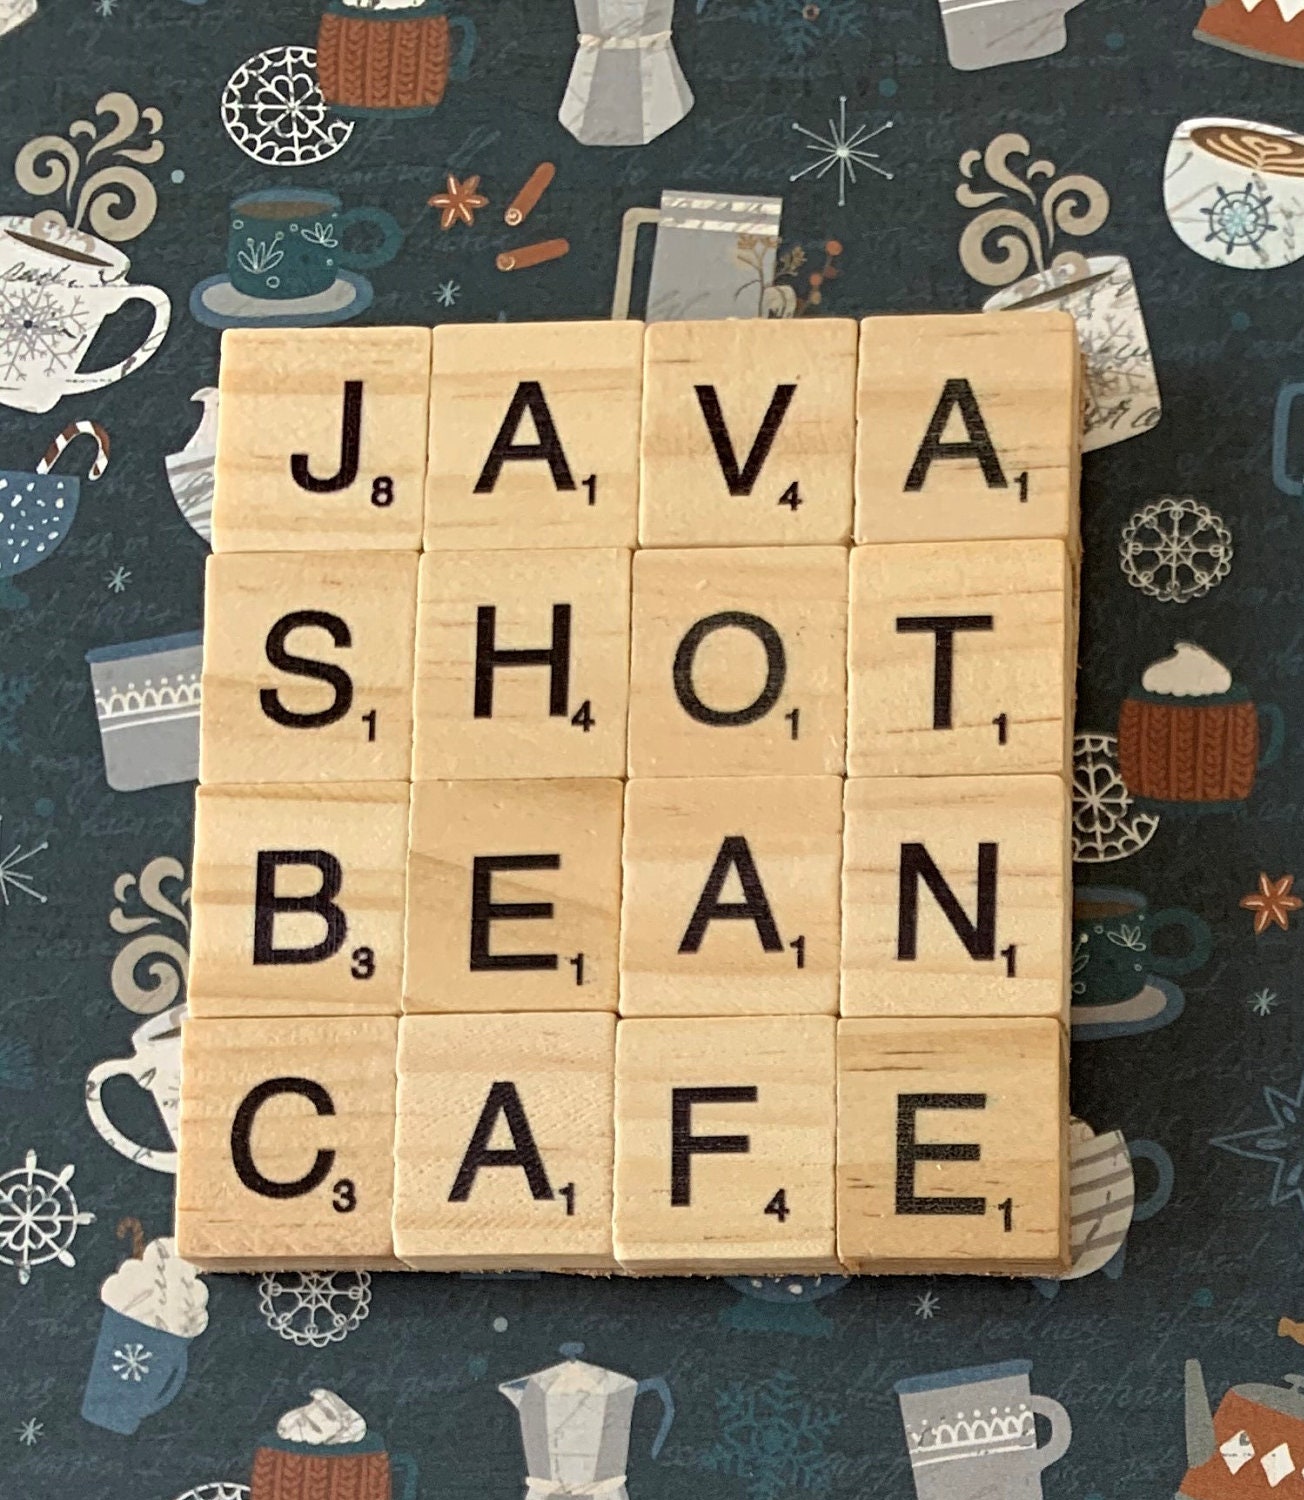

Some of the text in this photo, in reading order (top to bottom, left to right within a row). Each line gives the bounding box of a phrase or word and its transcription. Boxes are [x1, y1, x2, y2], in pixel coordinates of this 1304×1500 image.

[370, 470, 1030, 512] 8 1 4 1
[360, 699, 1009, 746] 1 4 1 1
[349, 934, 1018, 987] 3 1 1 1
[331, 1177, 1014, 1234] 3 1 4 1
